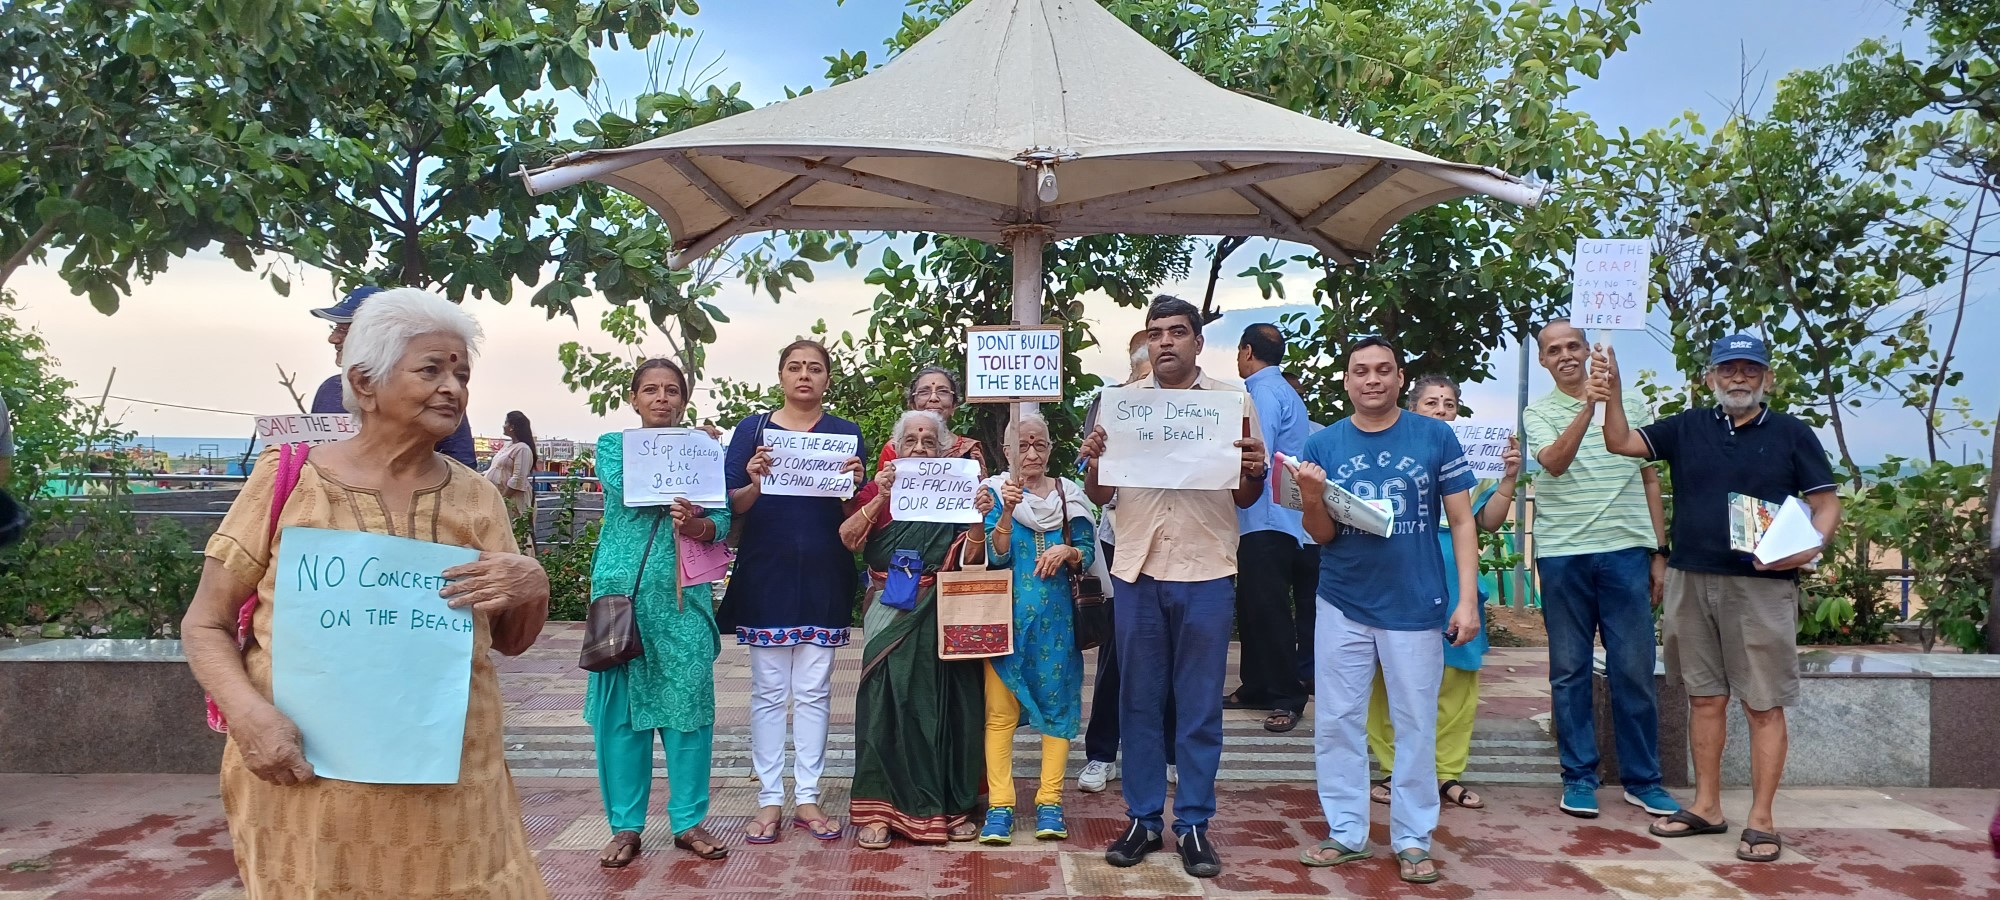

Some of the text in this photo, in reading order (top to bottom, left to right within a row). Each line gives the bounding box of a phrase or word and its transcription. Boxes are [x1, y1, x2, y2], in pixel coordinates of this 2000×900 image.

[1581, 242, 1645, 255] CUT THE
[1585, 260, 1637, 273] CRAP!
[1577, 279, 1637, 288] SAY NO TO
[1585, 313, 1622, 324] HERE
[977, 333, 1060, 351] DONT BUILD
[978, 355, 1058, 371] TOILET ON
[976, 374, 1059, 390] THE BEACH
[1116, 400, 1153, 421] STOP
[257, 416, 299, 437] SAVE
[300, 416, 331, 432] THE
[1136, 427, 1154, 440] THE
[1463, 425, 1484, 439] THE
[638, 438, 719, 461] Stop defacing
[766, 435, 855, 454] SAVE THE BEACH
[668, 461, 691, 472] the
[784, 457, 848, 472] CONSTRUCTI
[918, 462, 952, 476] STOP
[652, 473, 700, 489] Beach
[763, 472, 852, 492] IN SAND AREA
[901, 478, 973, 493] DE-FACING
[1395, 456, 1430, 517] FIELD
[898, 496, 929, 511] OUR
[1350, 476, 1407, 517] 96
[298, 554, 345, 591] NO
[320, 608, 473, 633] ON THE BEACH
